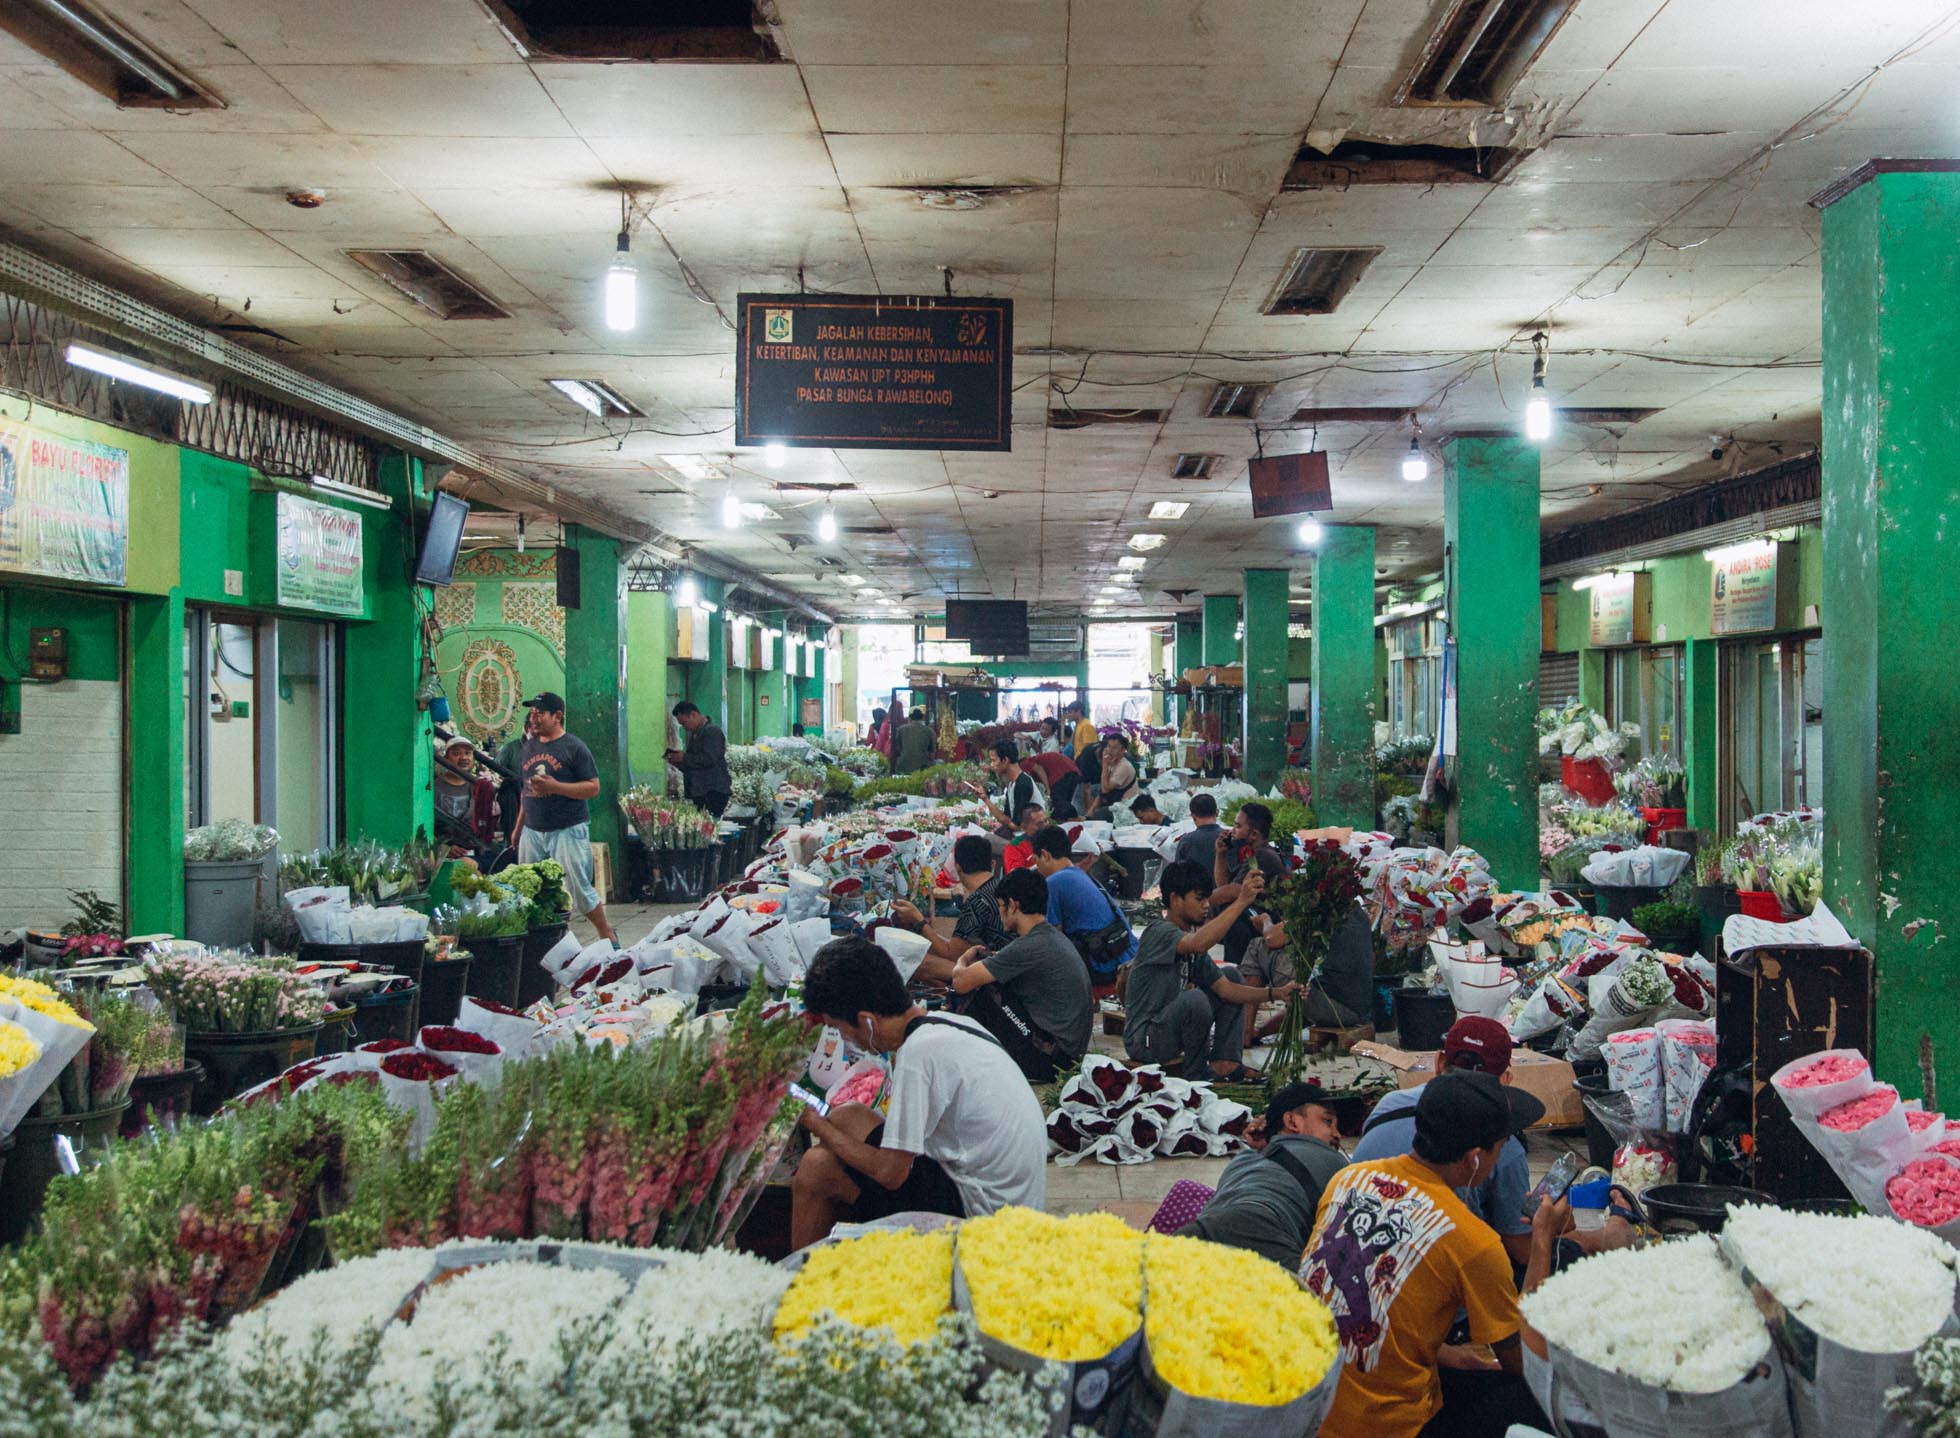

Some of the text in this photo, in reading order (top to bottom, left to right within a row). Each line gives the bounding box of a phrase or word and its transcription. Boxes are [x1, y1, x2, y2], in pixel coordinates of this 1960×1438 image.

[816, 325, 934, 344] JAGALAH KEBERSIHAN,
[756, 345, 994, 364] KETERTIBAN, KEAMANAN DAN KENYAMANAN
[814, 367, 869, 382] KAWASAN
[872, 368, 891, 383] UPT
[796, 384, 953, 407] (PASAR BUNGA RAWABELONG)
[31, 439, 68, 472] BAYU
[1002, 1005, 1031, 1036] Superstar
